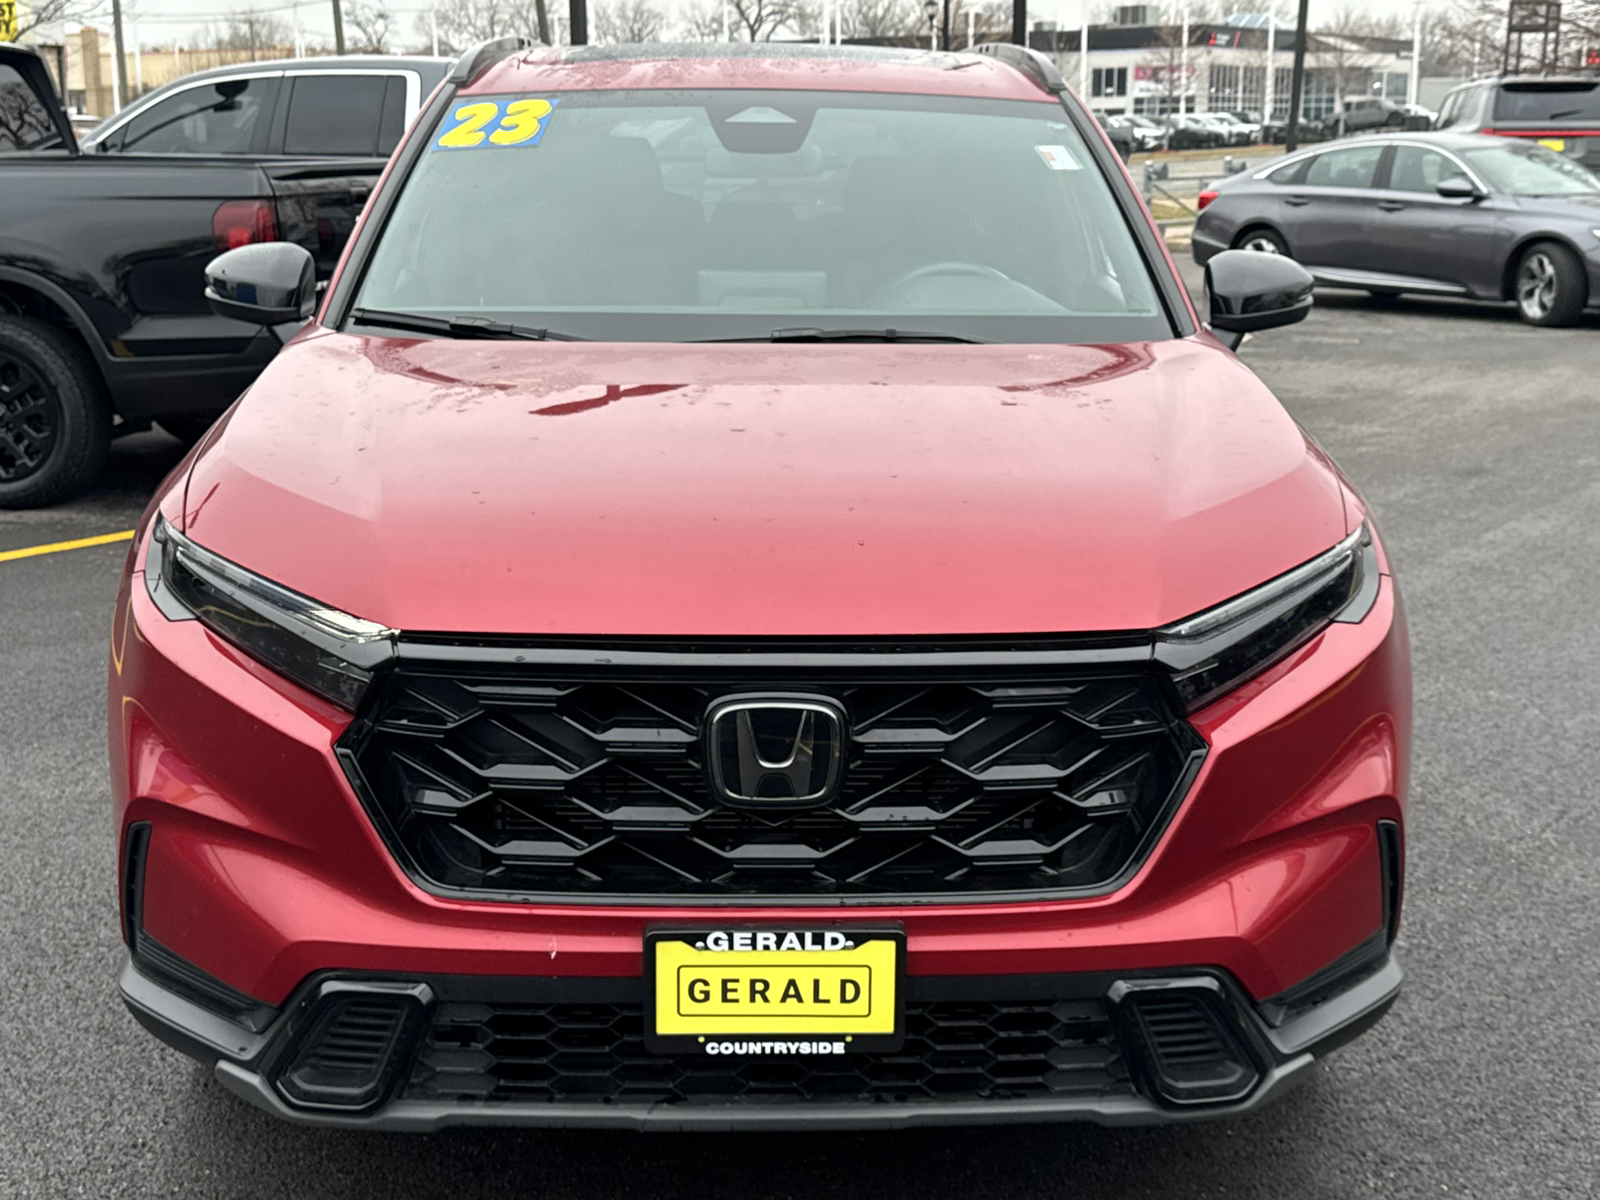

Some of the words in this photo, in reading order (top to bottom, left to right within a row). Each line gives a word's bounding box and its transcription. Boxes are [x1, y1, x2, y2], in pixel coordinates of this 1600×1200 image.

[438, 98, 552, 147] 23
[706, 931, 846, 951] GERALD
[687, 978, 861, 1004] GERALD
[705, 1042, 846, 1055] COUNTRYSIDE
